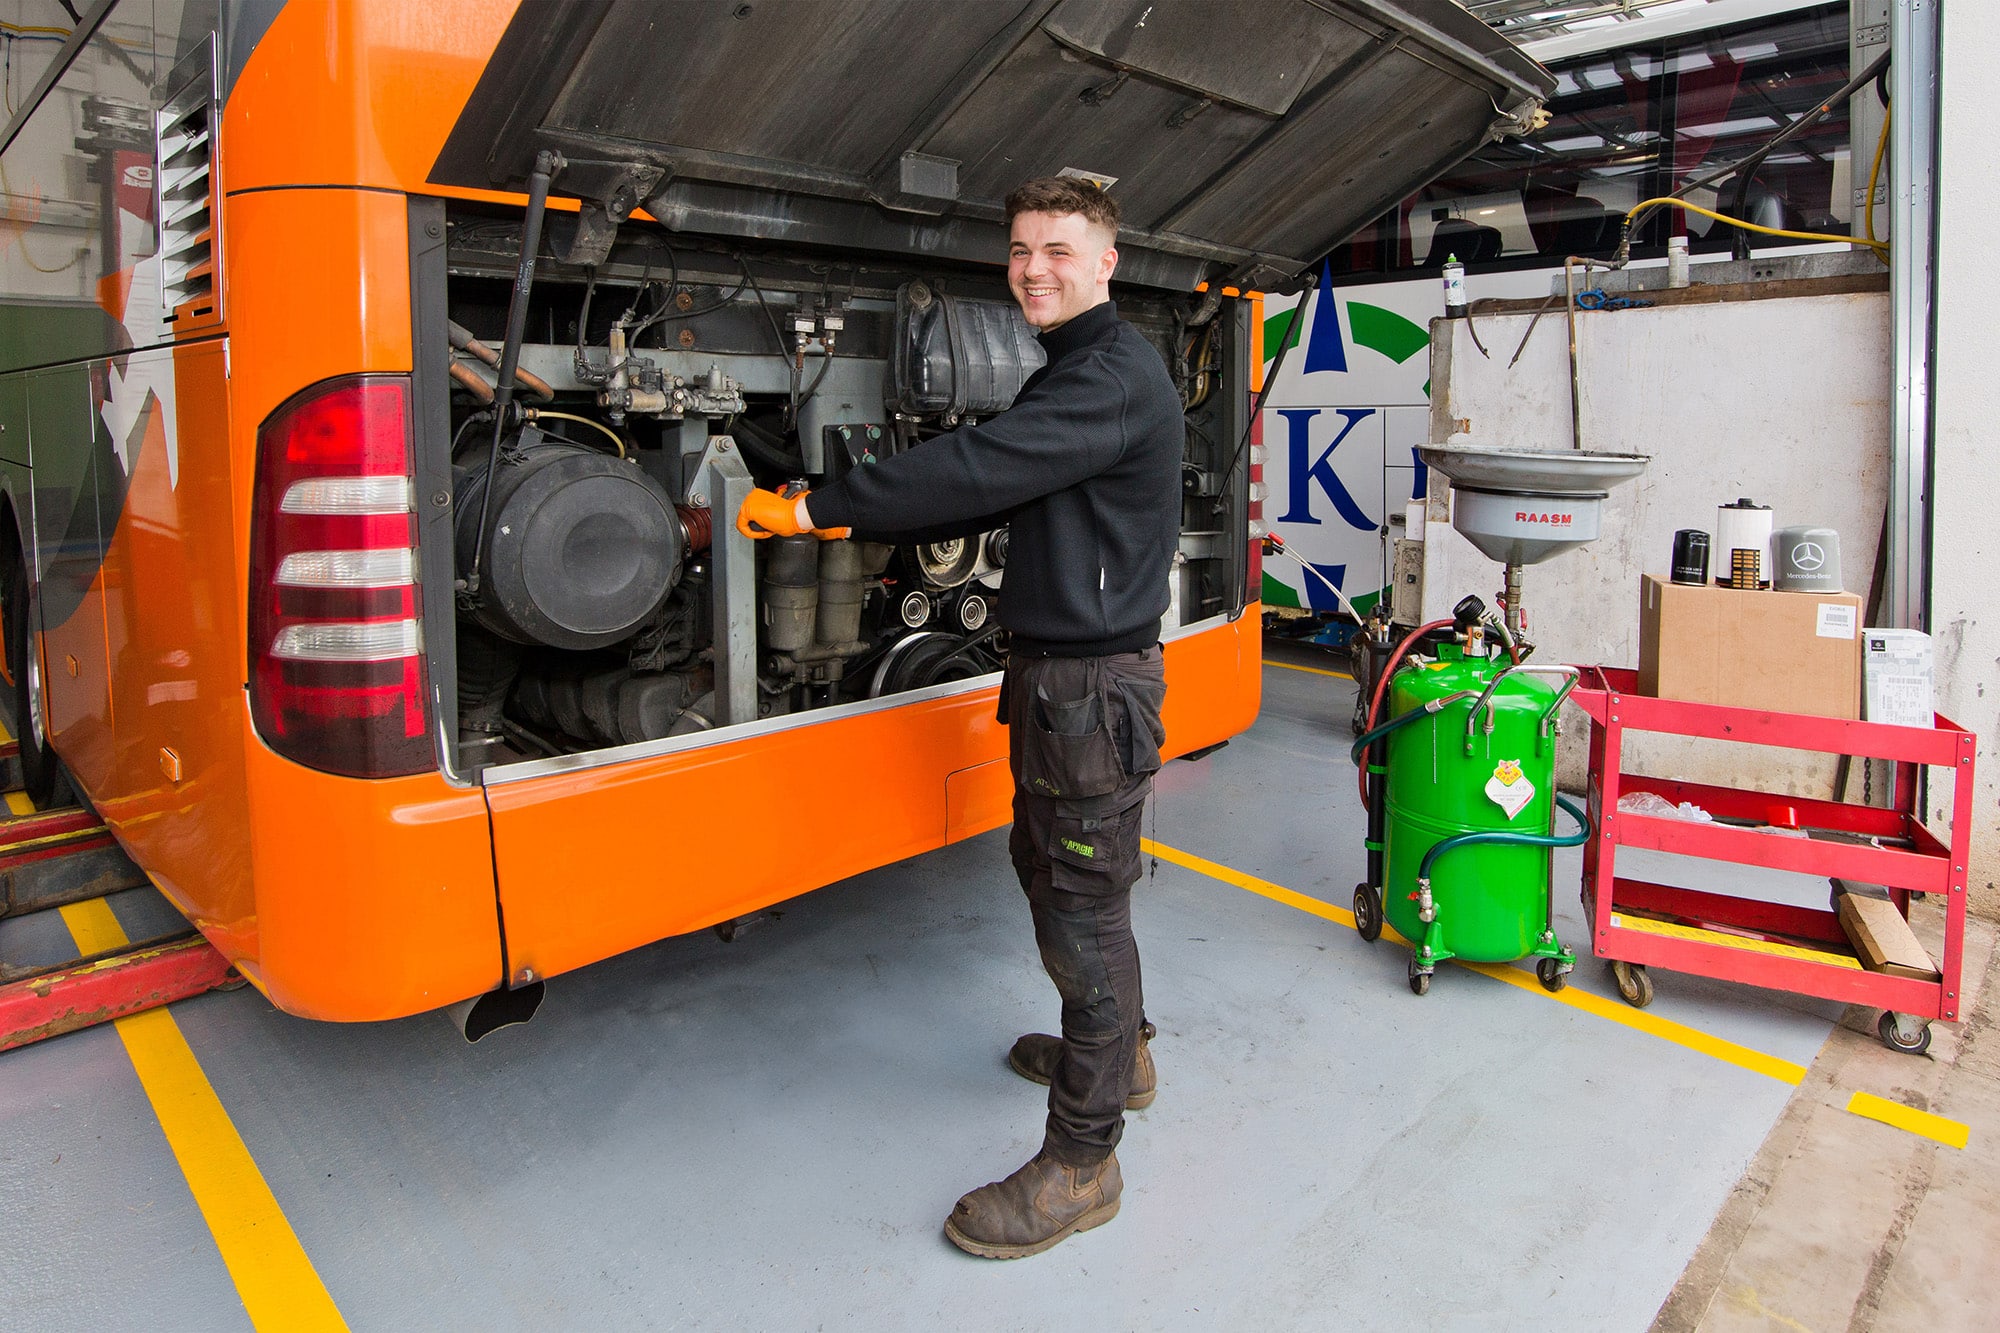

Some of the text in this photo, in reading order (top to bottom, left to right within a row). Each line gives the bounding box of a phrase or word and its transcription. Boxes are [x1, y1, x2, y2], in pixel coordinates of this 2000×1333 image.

[1277, 408, 1379, 531] K
[1515, 511, 1572, 524] RAASM
[1786, 572, 1832, 580] Mercedes-Benz
[1066, 840, 1095, 856] APACHE
